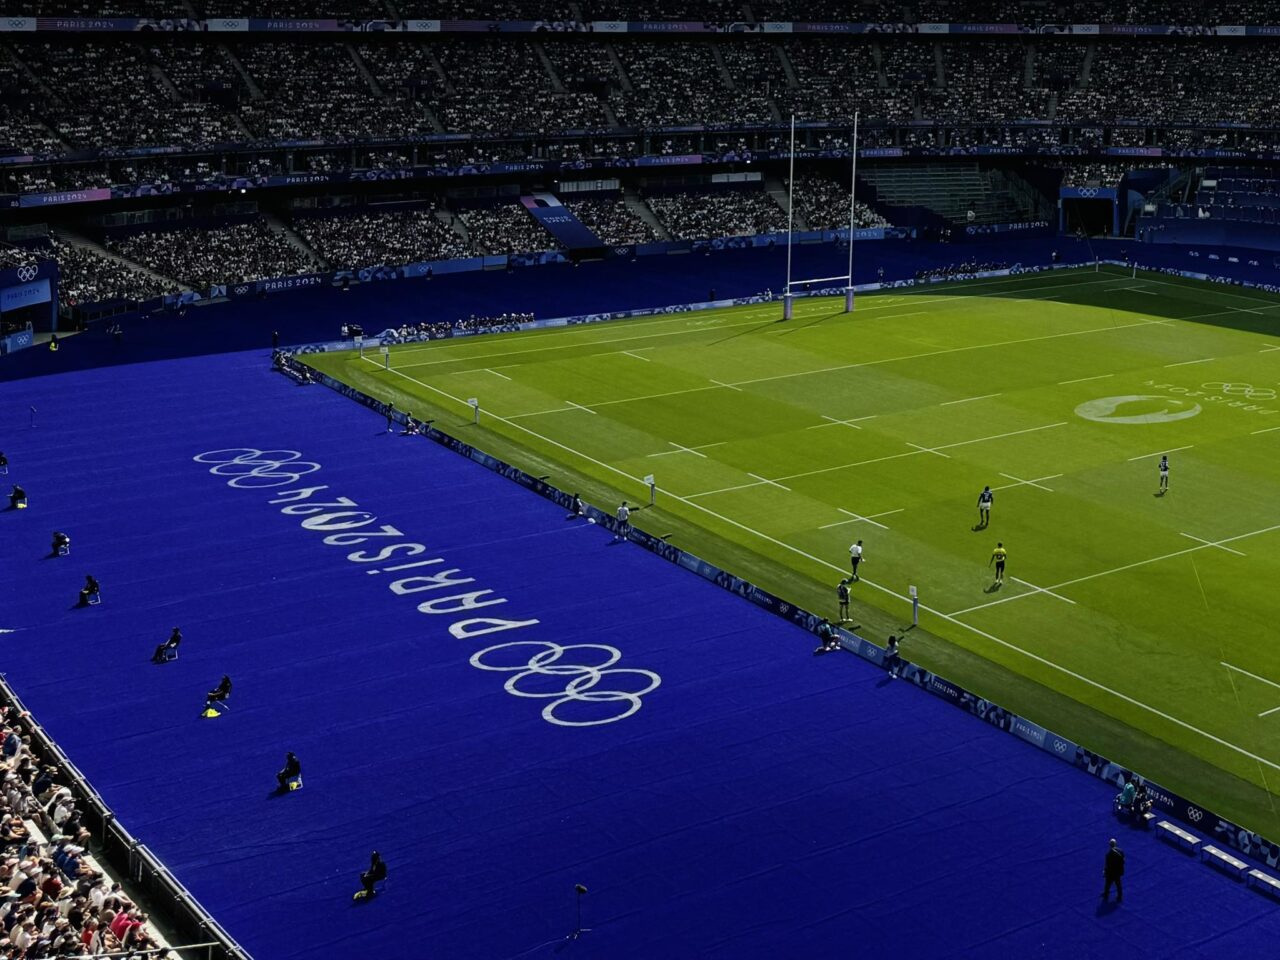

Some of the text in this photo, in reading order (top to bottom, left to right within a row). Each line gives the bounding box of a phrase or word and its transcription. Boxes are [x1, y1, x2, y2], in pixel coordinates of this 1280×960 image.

[57, 20, 114, 28] PARIS 2024
[267, 21, 320, 29] PARIS 2024
[43, 195, 66, 203] PARIS
[265, 277, 322, 291] PARIS 2024
[1143, 380, 1279, 415] PARIS 2024
[268, 485, 540, 640] PARIS 2024
